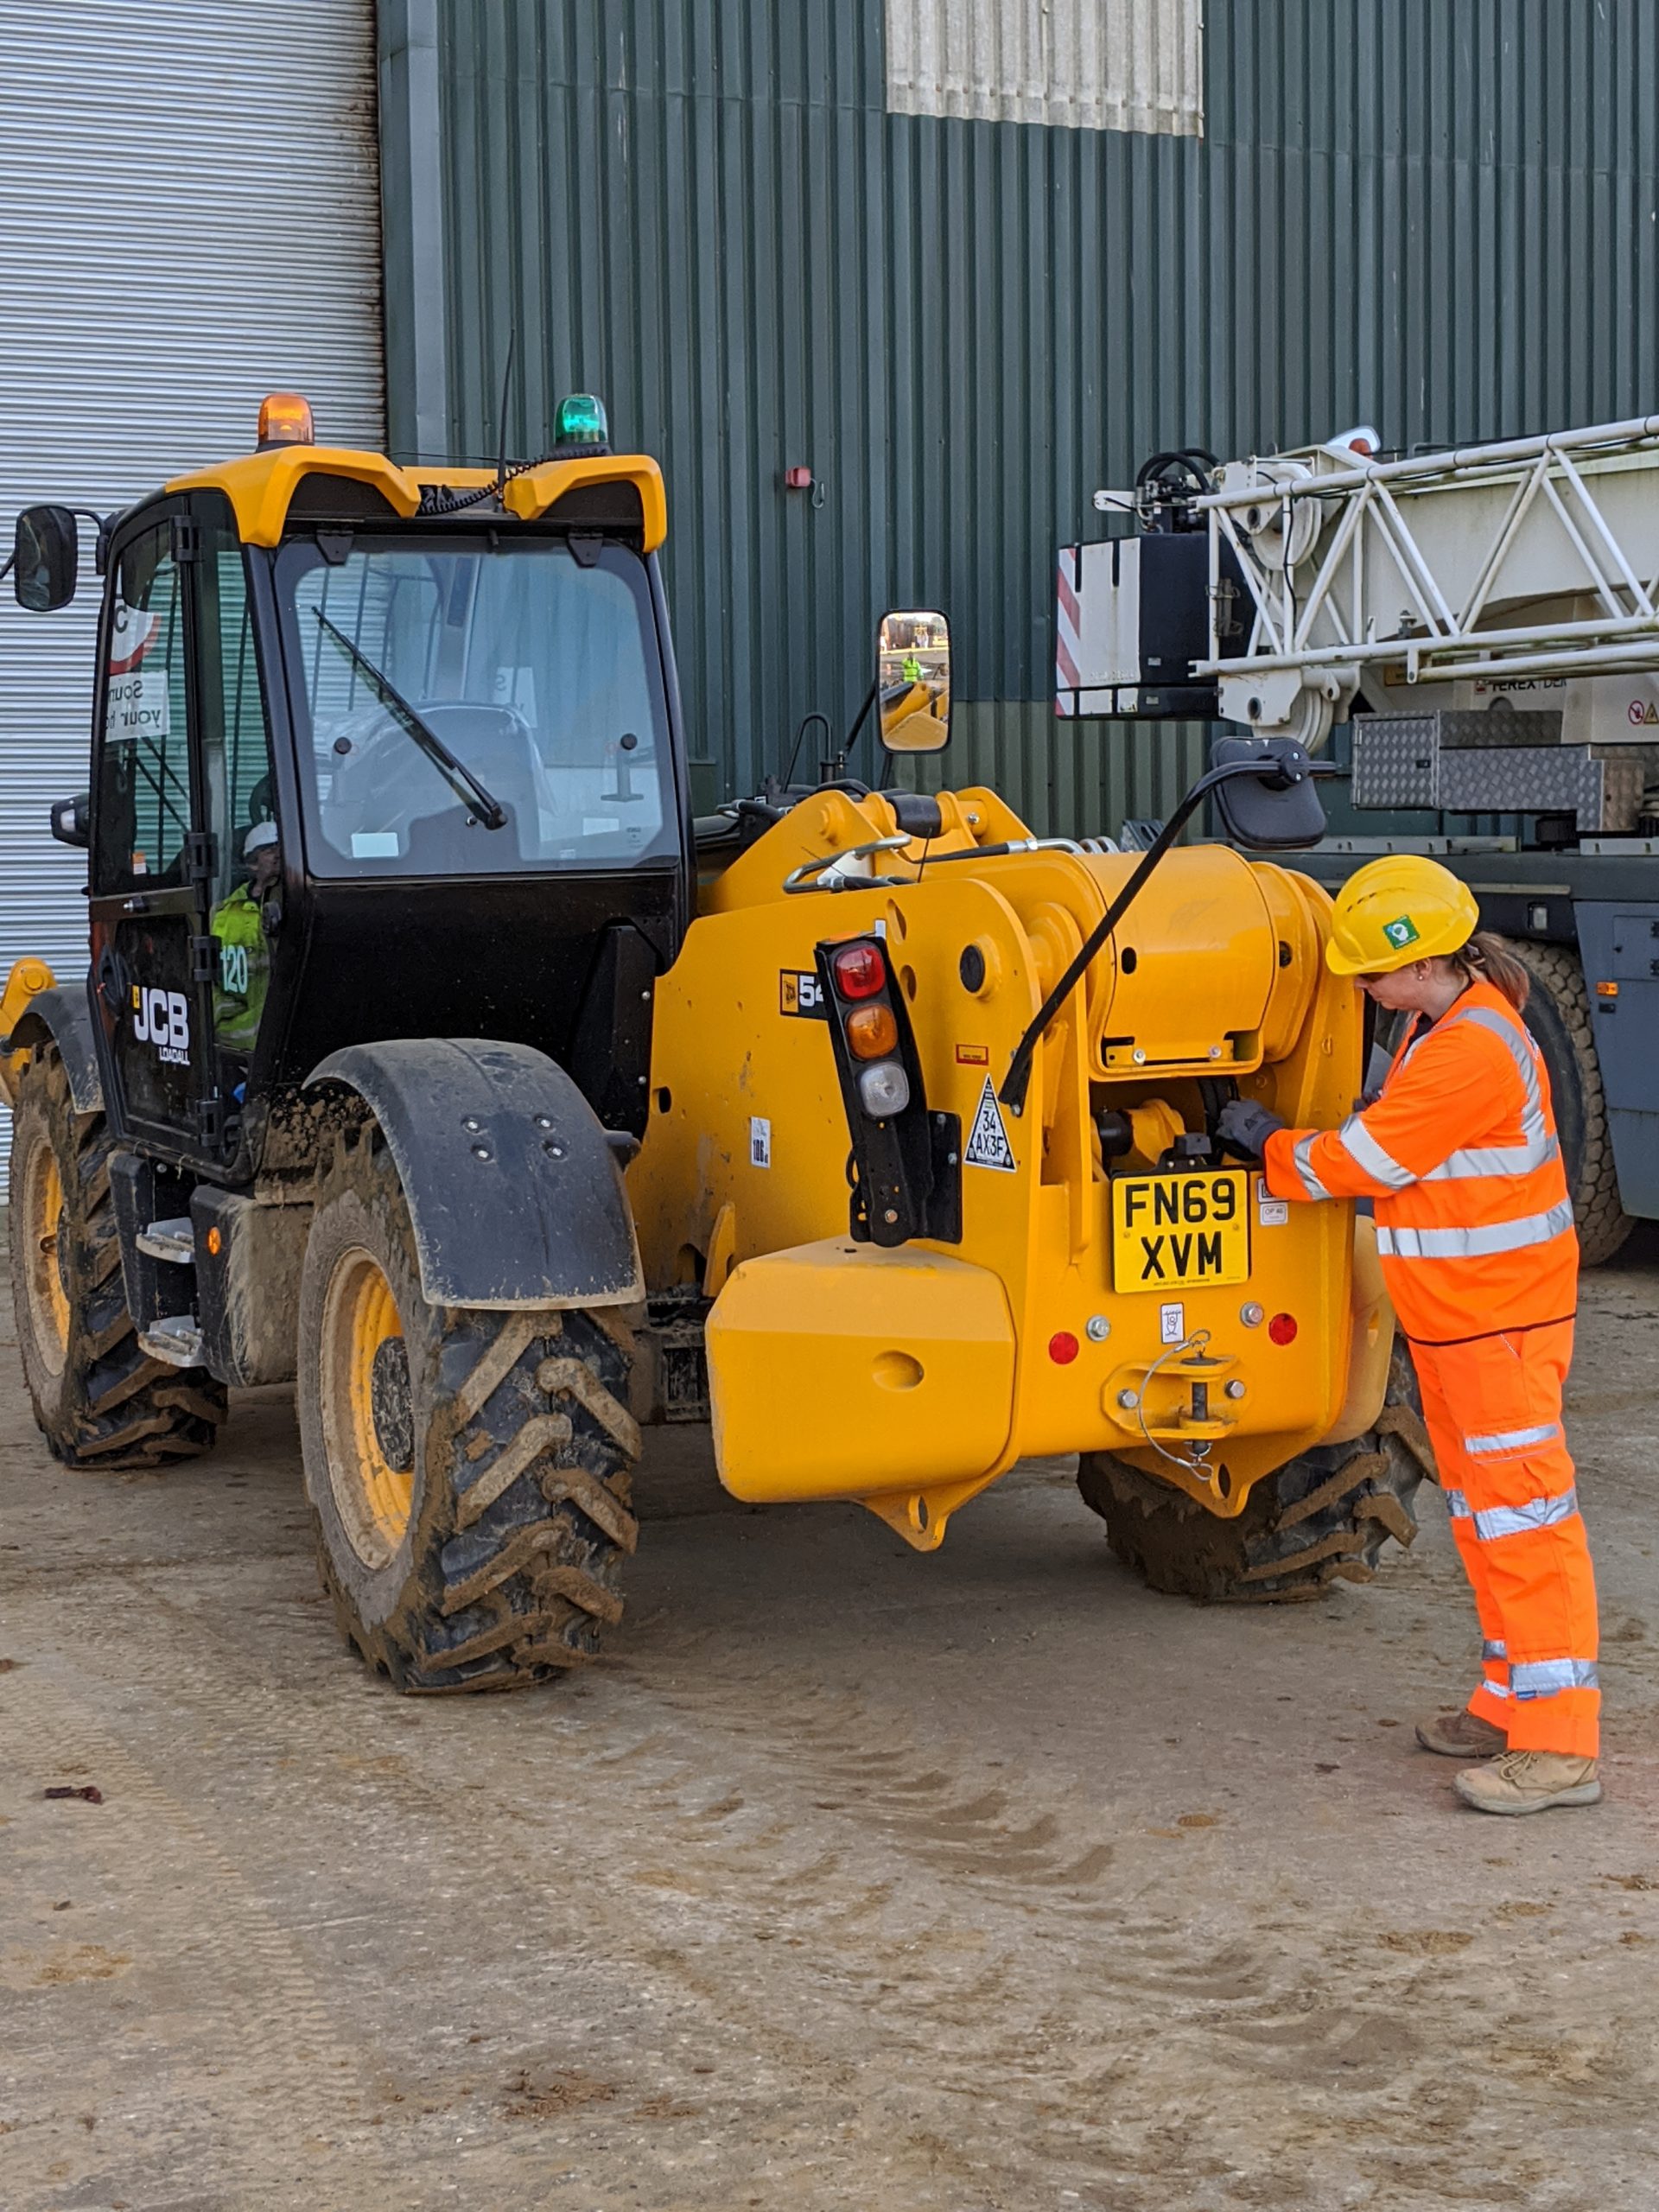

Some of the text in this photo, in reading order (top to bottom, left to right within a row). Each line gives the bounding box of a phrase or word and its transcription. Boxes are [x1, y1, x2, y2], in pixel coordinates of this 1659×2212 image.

[220, 944, 248, 994] 120
[133, 985, 189, 1050] JCB
[159, 1046, 190, 1065] LOADALL
[976, 1133, 1005, 1158] AX3F
[982, 1110, 996, 1134] 34
[1125, 1177, 1236, 1228] FN69
[1141, 1230, 1223, 1281] XVM
